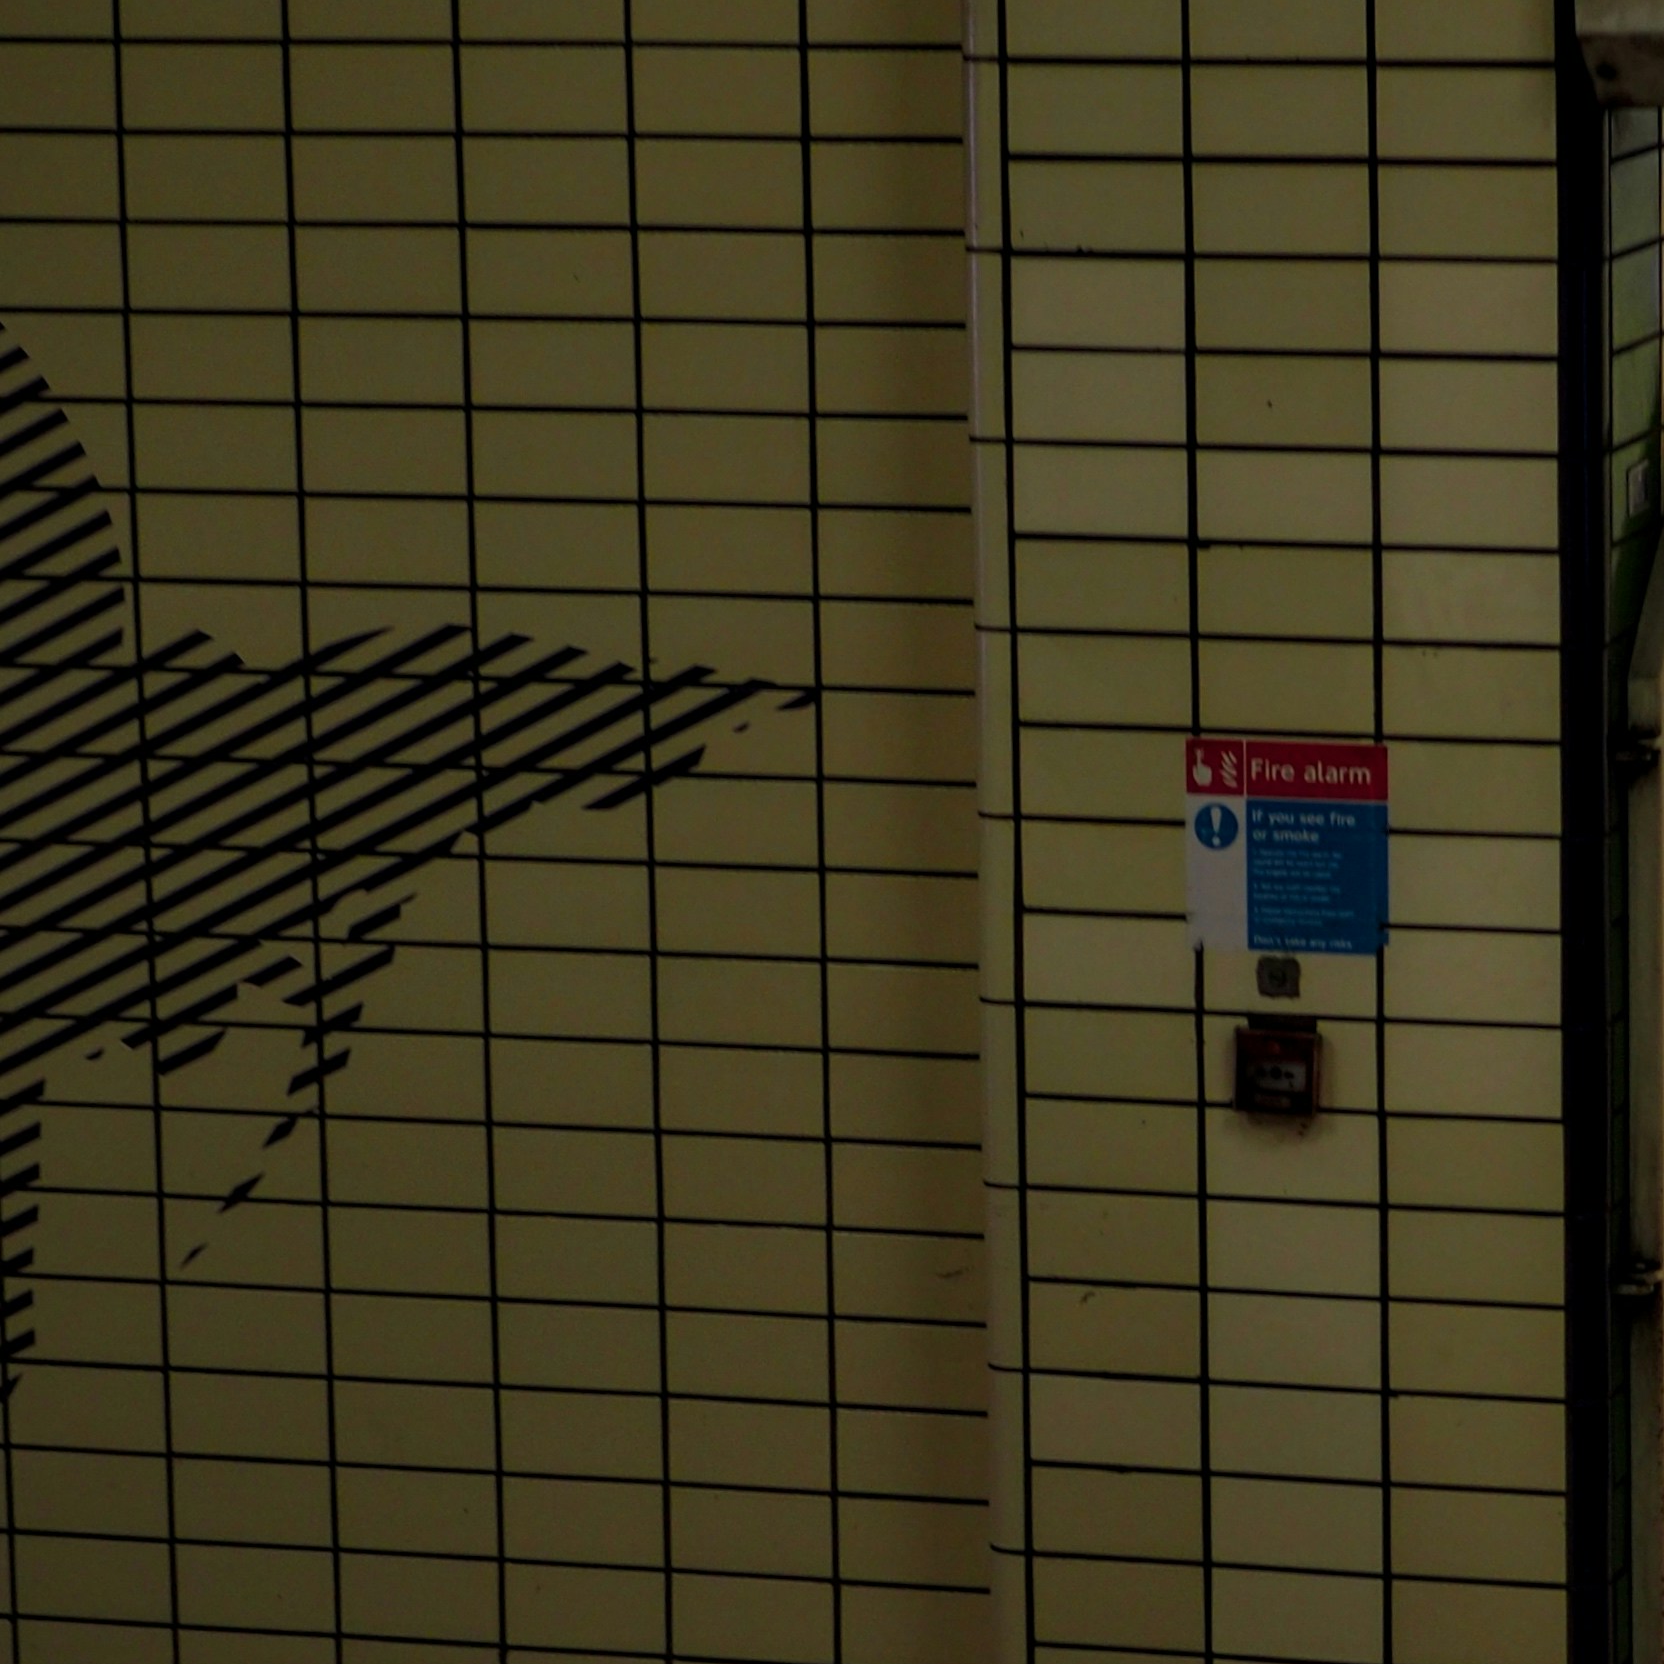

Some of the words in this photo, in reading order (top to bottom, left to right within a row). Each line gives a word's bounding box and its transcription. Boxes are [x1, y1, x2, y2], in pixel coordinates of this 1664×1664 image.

[1250, 757, 1295, 783] Fire
[1303, 760, 1372, 785] alarm
[1251, 808, 1264, 823] If
[1268, 812, 1295, 827] you
[1299, 813, 1325, 826] see
[1329, 810, 1356, 828] fire
[1252, 828, 1267, 841] or
[1272, 828, 1320, 843] smoke
